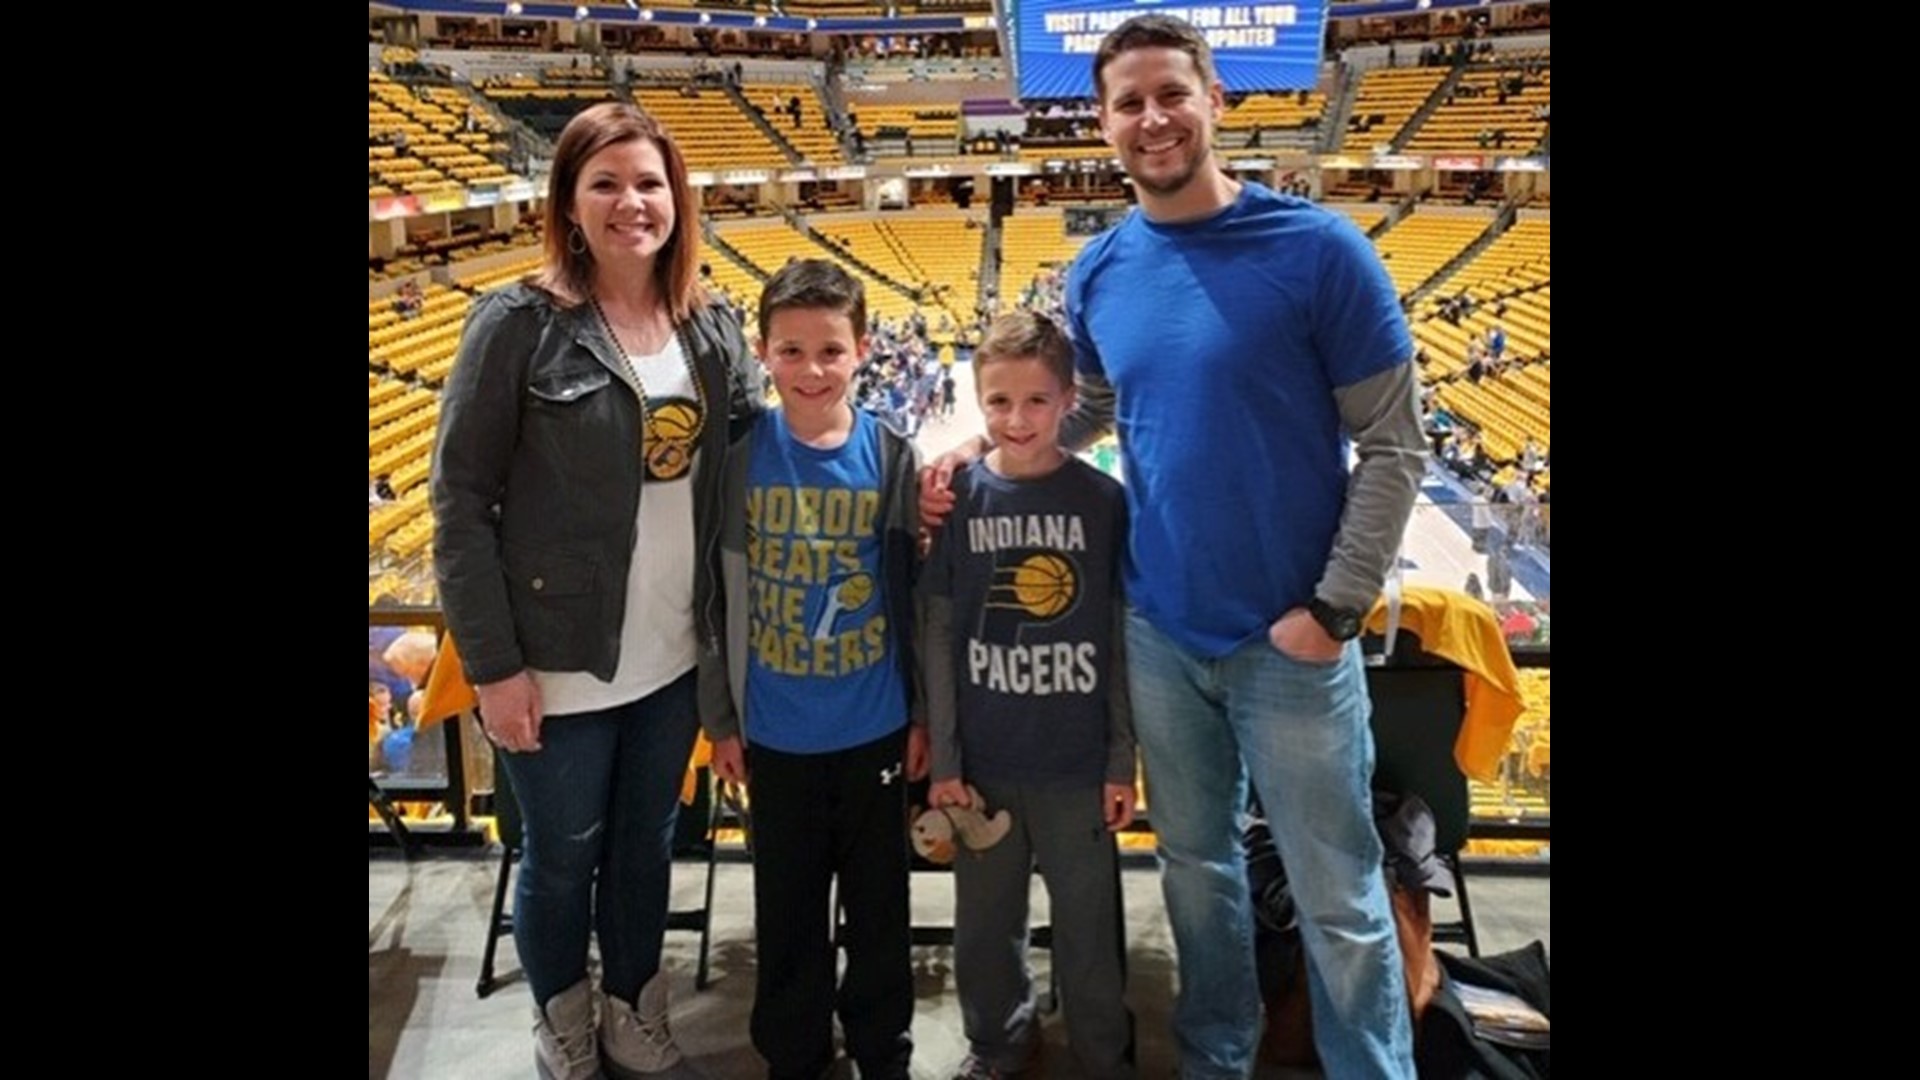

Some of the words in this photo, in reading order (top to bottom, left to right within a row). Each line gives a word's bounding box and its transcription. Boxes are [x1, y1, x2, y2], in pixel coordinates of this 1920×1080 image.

[1192, 8, 1220, 27] FOR
[1225, 7, 1250, 25] ALL
[1255, 6, 1296, 24] YOUR
[747, 487, 880, 536] NOBOD
[968, 514, 1086, 552] INDIANA
[968, 638, 1098, 695] PACERS
